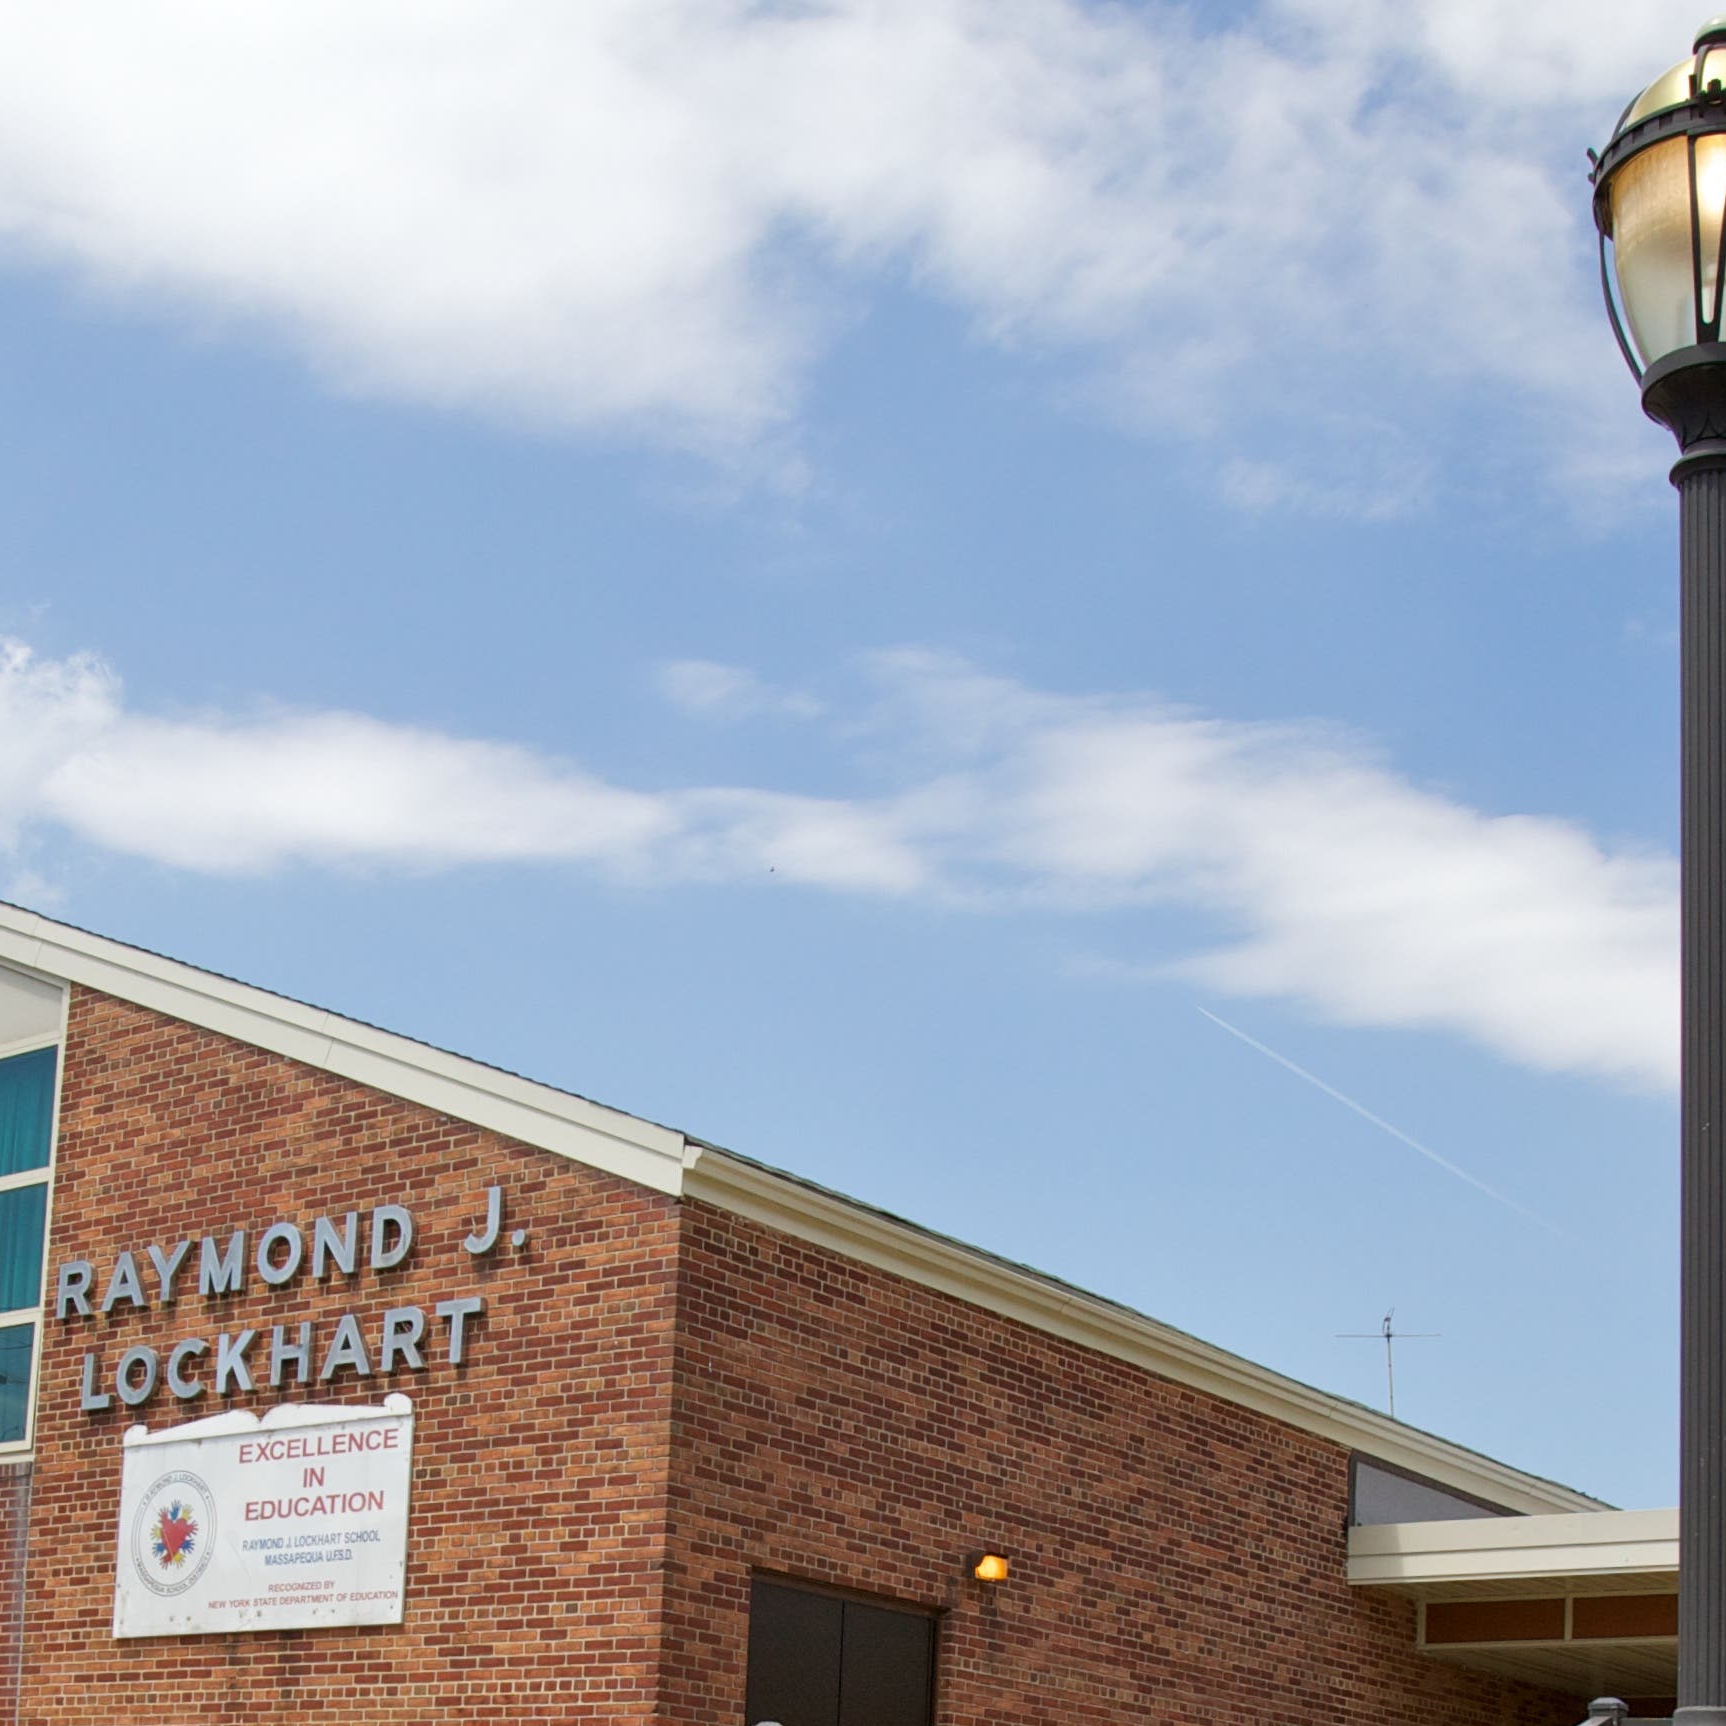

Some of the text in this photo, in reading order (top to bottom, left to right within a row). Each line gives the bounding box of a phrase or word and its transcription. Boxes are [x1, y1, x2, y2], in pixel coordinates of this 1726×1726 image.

[56, 1186, 527, 1320] RAYMOND J.
[81, 1297, 486, 1410] LOCKHART
[239, 1428, 399, 1464] EXCELLENCE
[303, 1466, 325, 1488] IN
[245, 1490, 384, 1521] EDUCATION
[242, 1530, 381, 1551] RAYMOND J. LOCKHART SCHOOL
[264, 1551, 323, 1566] MASSAPEQUA
[268, 1580, 335, 1593] RECOGNIZED BY
[208, 1590, 398, 1609] NEW YORK STATE DEPARTMENT OF EDUCATION
